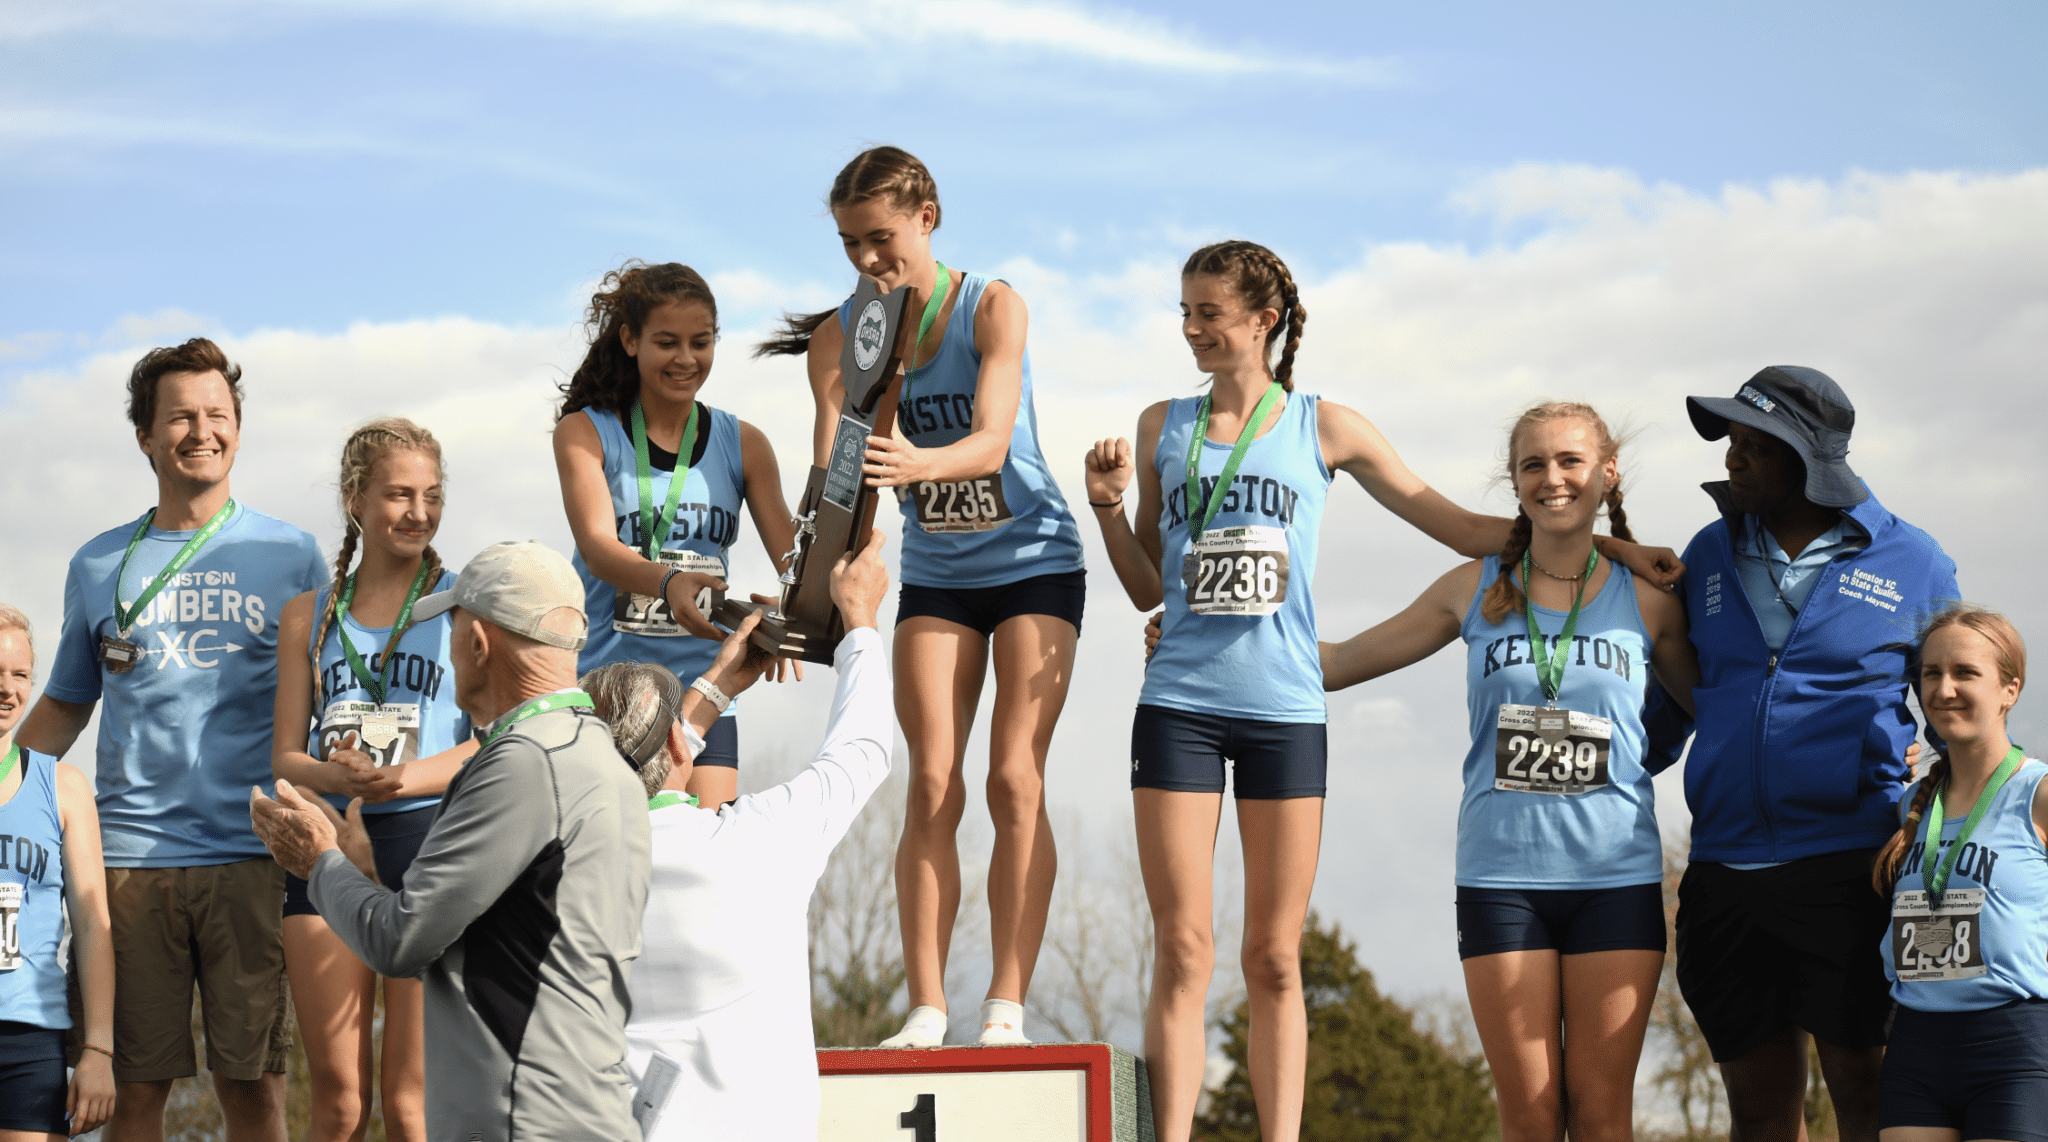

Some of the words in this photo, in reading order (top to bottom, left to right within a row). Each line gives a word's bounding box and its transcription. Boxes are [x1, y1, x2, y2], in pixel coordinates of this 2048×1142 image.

[838, 459, 854, 476] 2022
[919, 480, 998, 519] 2235
[1223, 529, 1246, 538] OHSAA
[659, 551, 683, 560] OHSAA
[671, 562, 723, 570] Championships
[142, 570, 236, 590] KNSTON
[1195, 555, 1278, 600] 2236
[1839, 573, 1850, 584] D1
[1850, 576, 1871, 591] State
[1873, 584, 1904, 603] Qualifier
[1853, 568, 1884, 586] Kenston
[1884, 578, 1897, 590] XC
[1839, 586, 1863, 600] Coach
[1864, 594, 1897, 612] Maynard
[157, 629, 219, 670] XC
[350, 703, 376, 712] OHSAA
[1500, 716, 1521, 724] Cross
[1507, 735, 1597, 782] 2239
[901, 1094, 937, 1142] 1
